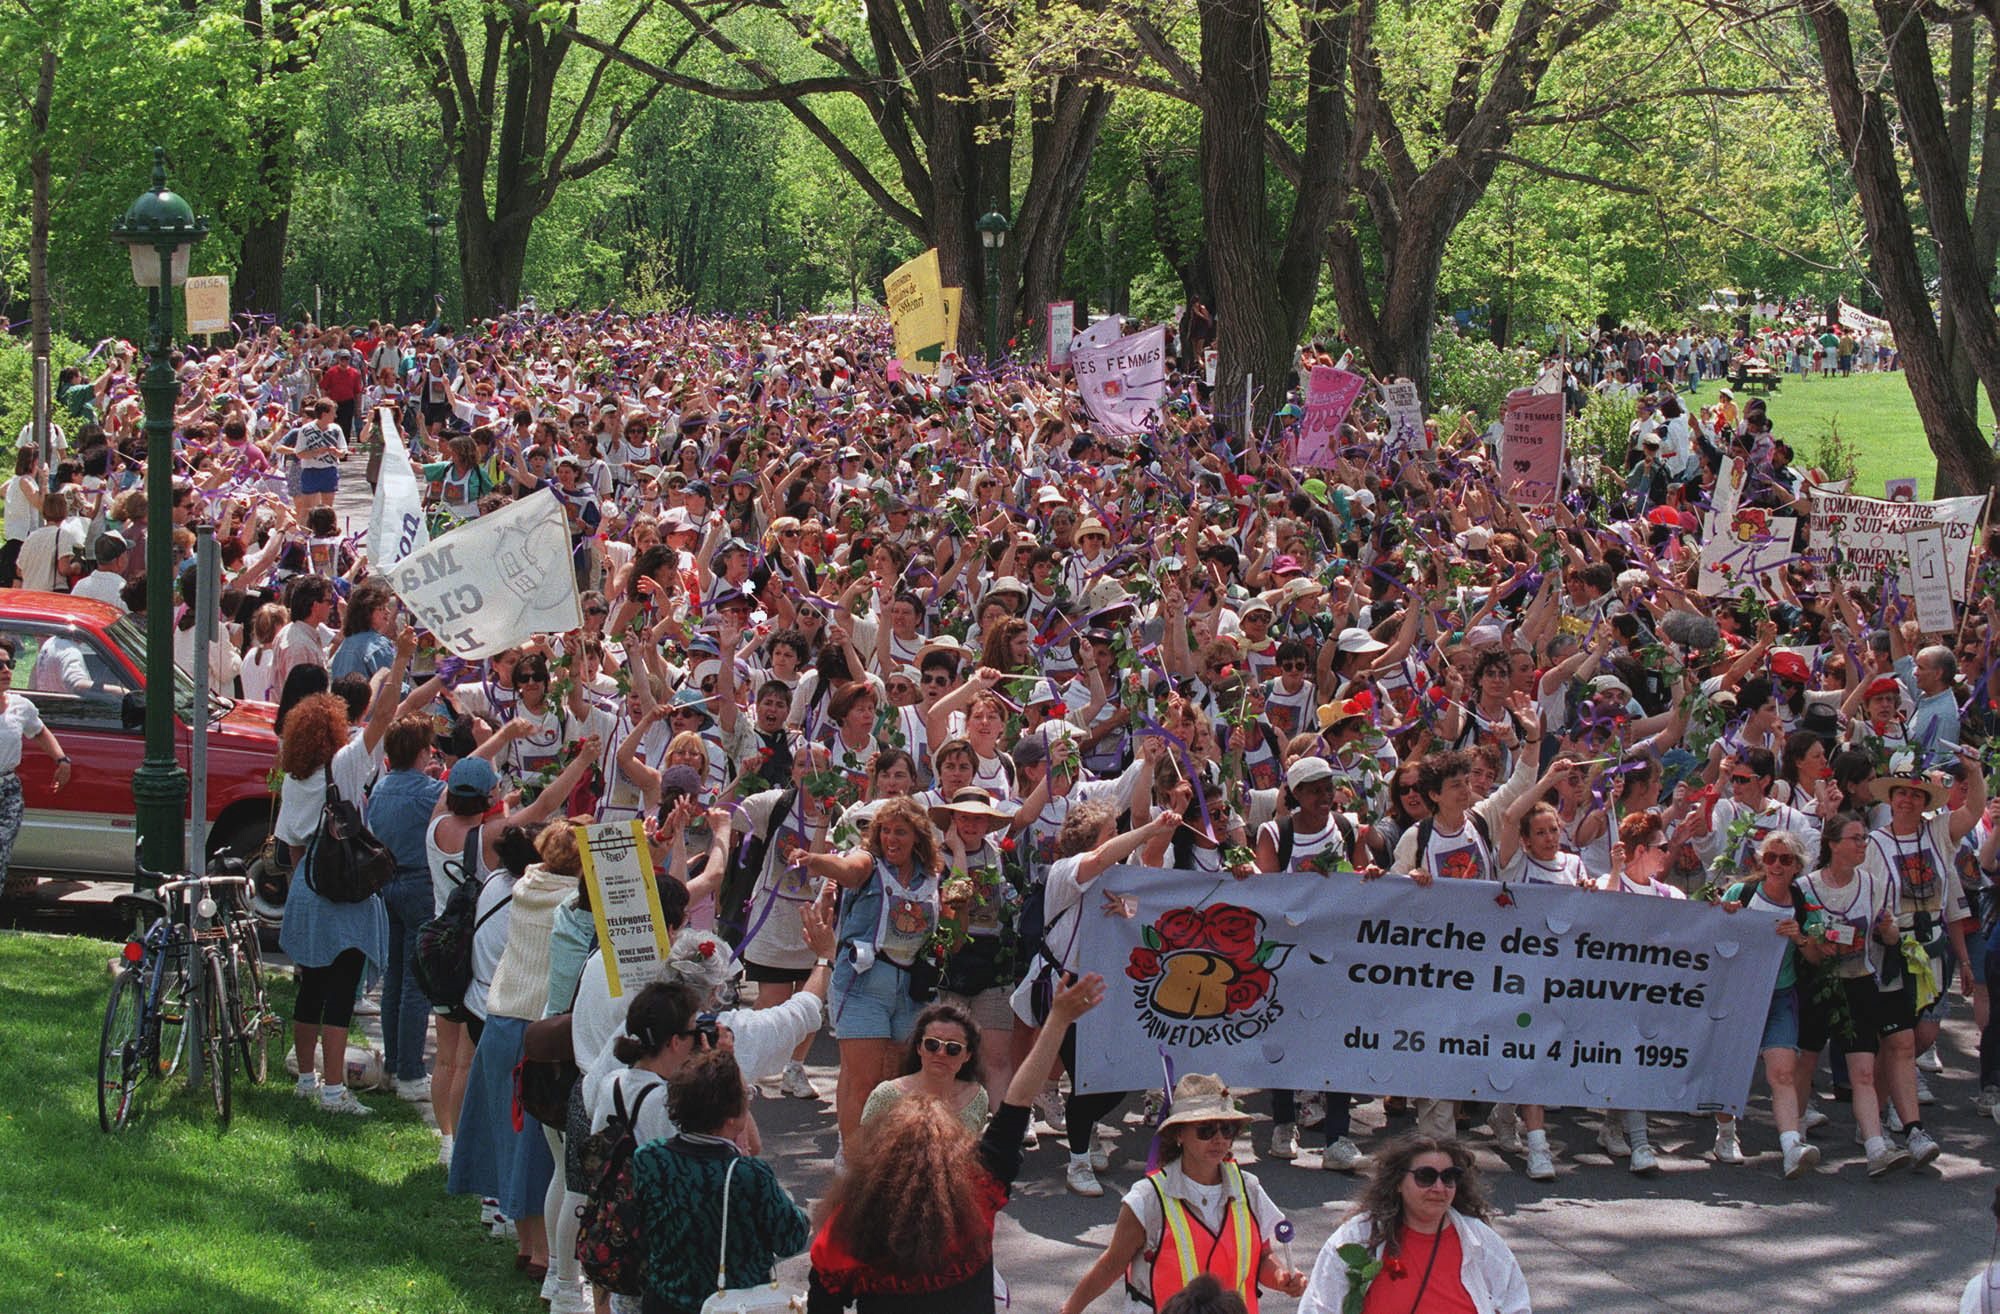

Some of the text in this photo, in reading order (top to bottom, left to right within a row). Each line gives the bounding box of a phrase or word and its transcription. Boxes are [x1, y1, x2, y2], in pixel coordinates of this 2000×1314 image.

[1106, 347, 1161, 372] FEMMES
[1514, 423, 1530, 433] DES
[1524, 412, 1562, 422] FEMMES
[1823, 497, 1936, 520] COMMUNAUTAIRE
[606, 913, 653, 928] TÉLÉPHONEZ
[1356, 919, 1710, 972] Marche des femmes
[1348, 962, 1708, 1009] contre la pauvreté
[1133, 985, 1285, 1048] DU PAIN ET DES ROSES
[1343, 1025, 1689, 1069] du 26 mai au 4 juin 1995
